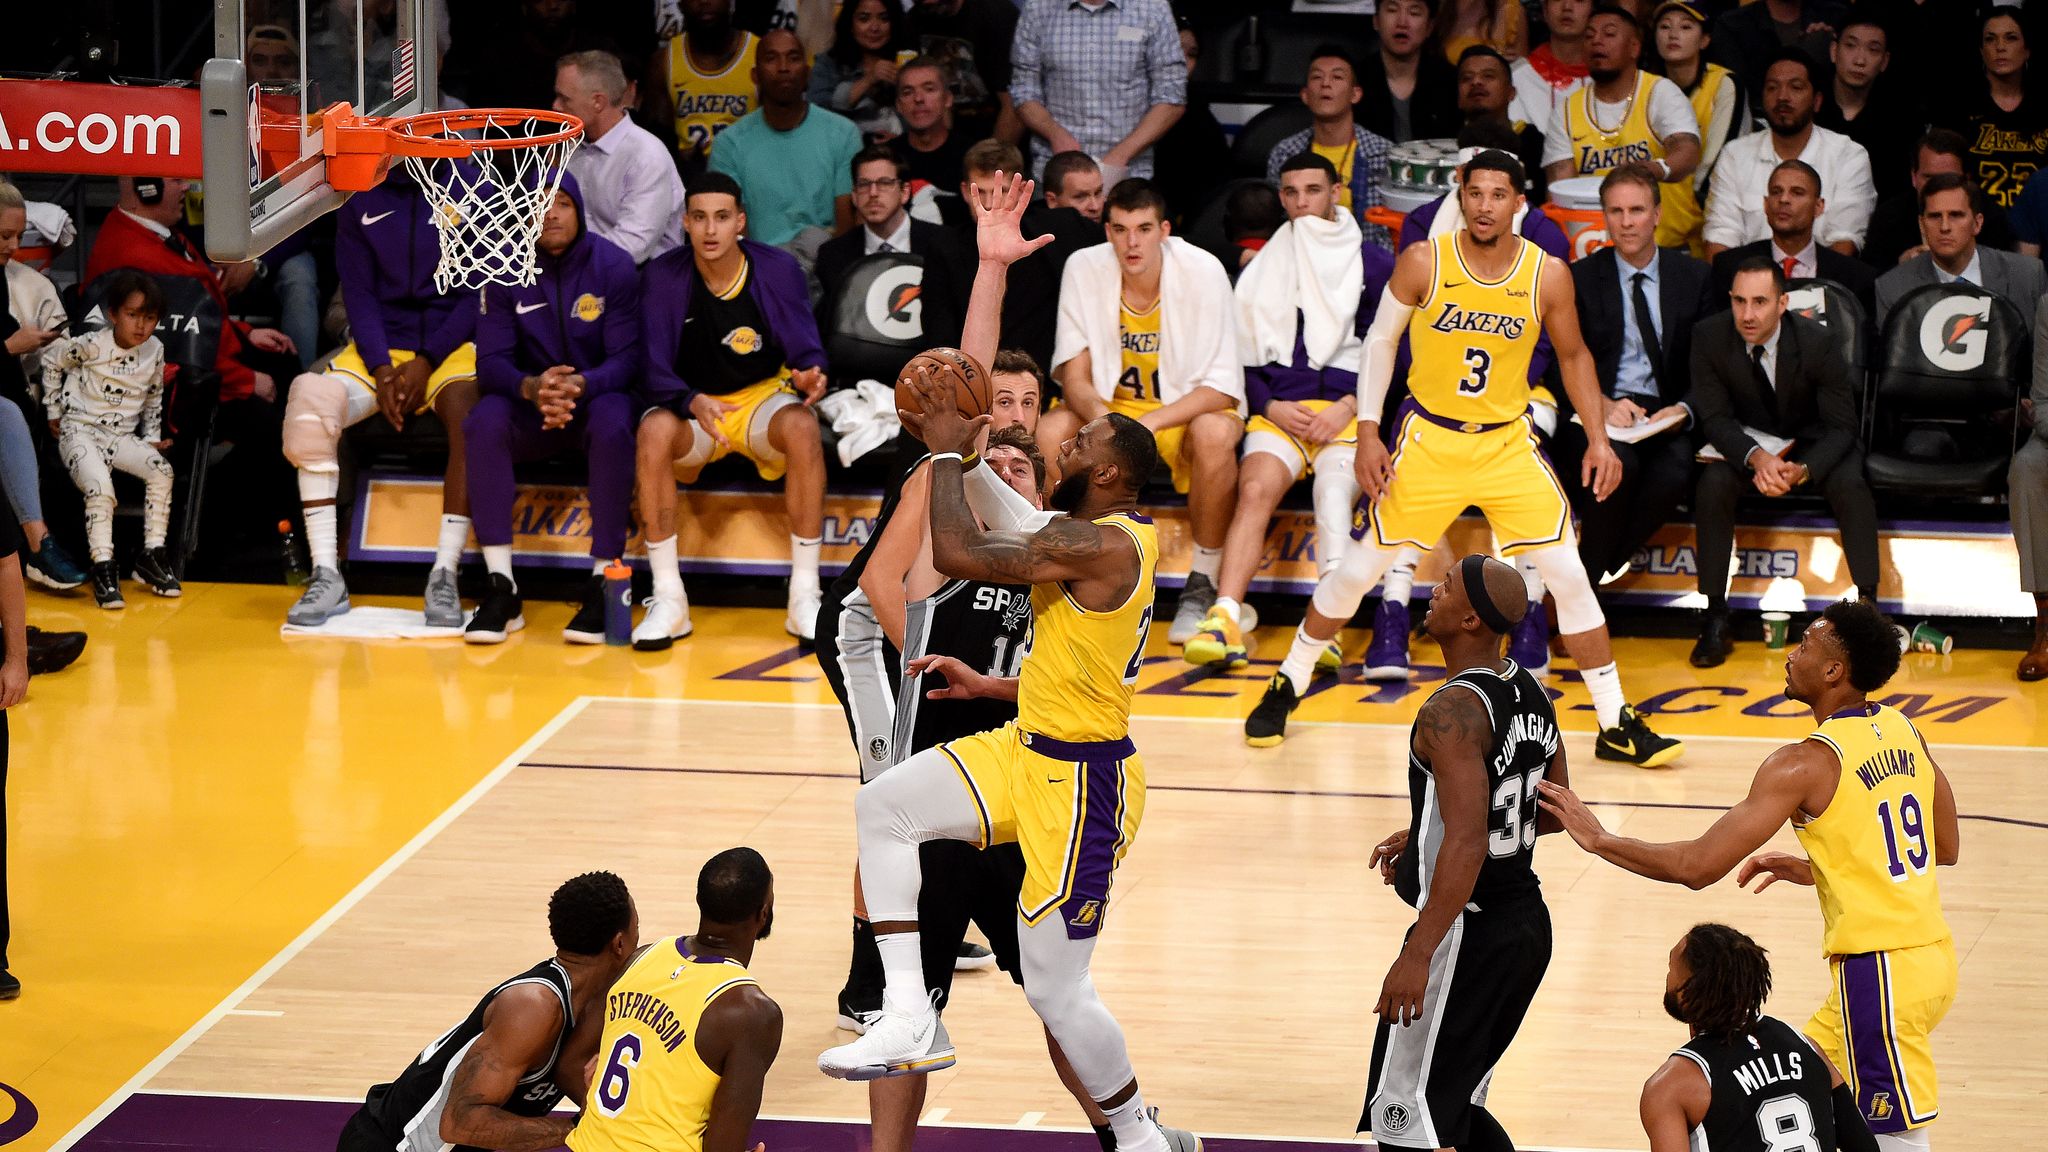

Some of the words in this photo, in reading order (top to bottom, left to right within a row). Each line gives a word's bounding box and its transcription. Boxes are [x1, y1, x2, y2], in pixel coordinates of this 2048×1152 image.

[676, 90, 748, 118] LAKERS
[1430, 302, 1526, 340] LAKERS
[1456, 345, 1492, 398] 3
[1855, 748, 1916, 791] WILLIAMS
[1877, 791, 1930, 884] 19
[609, 991, 687, 1054] STEPHENSON
[594, 1031, 643, 1119] 6
[1733, 1051, 1803, 1096] MILLS
